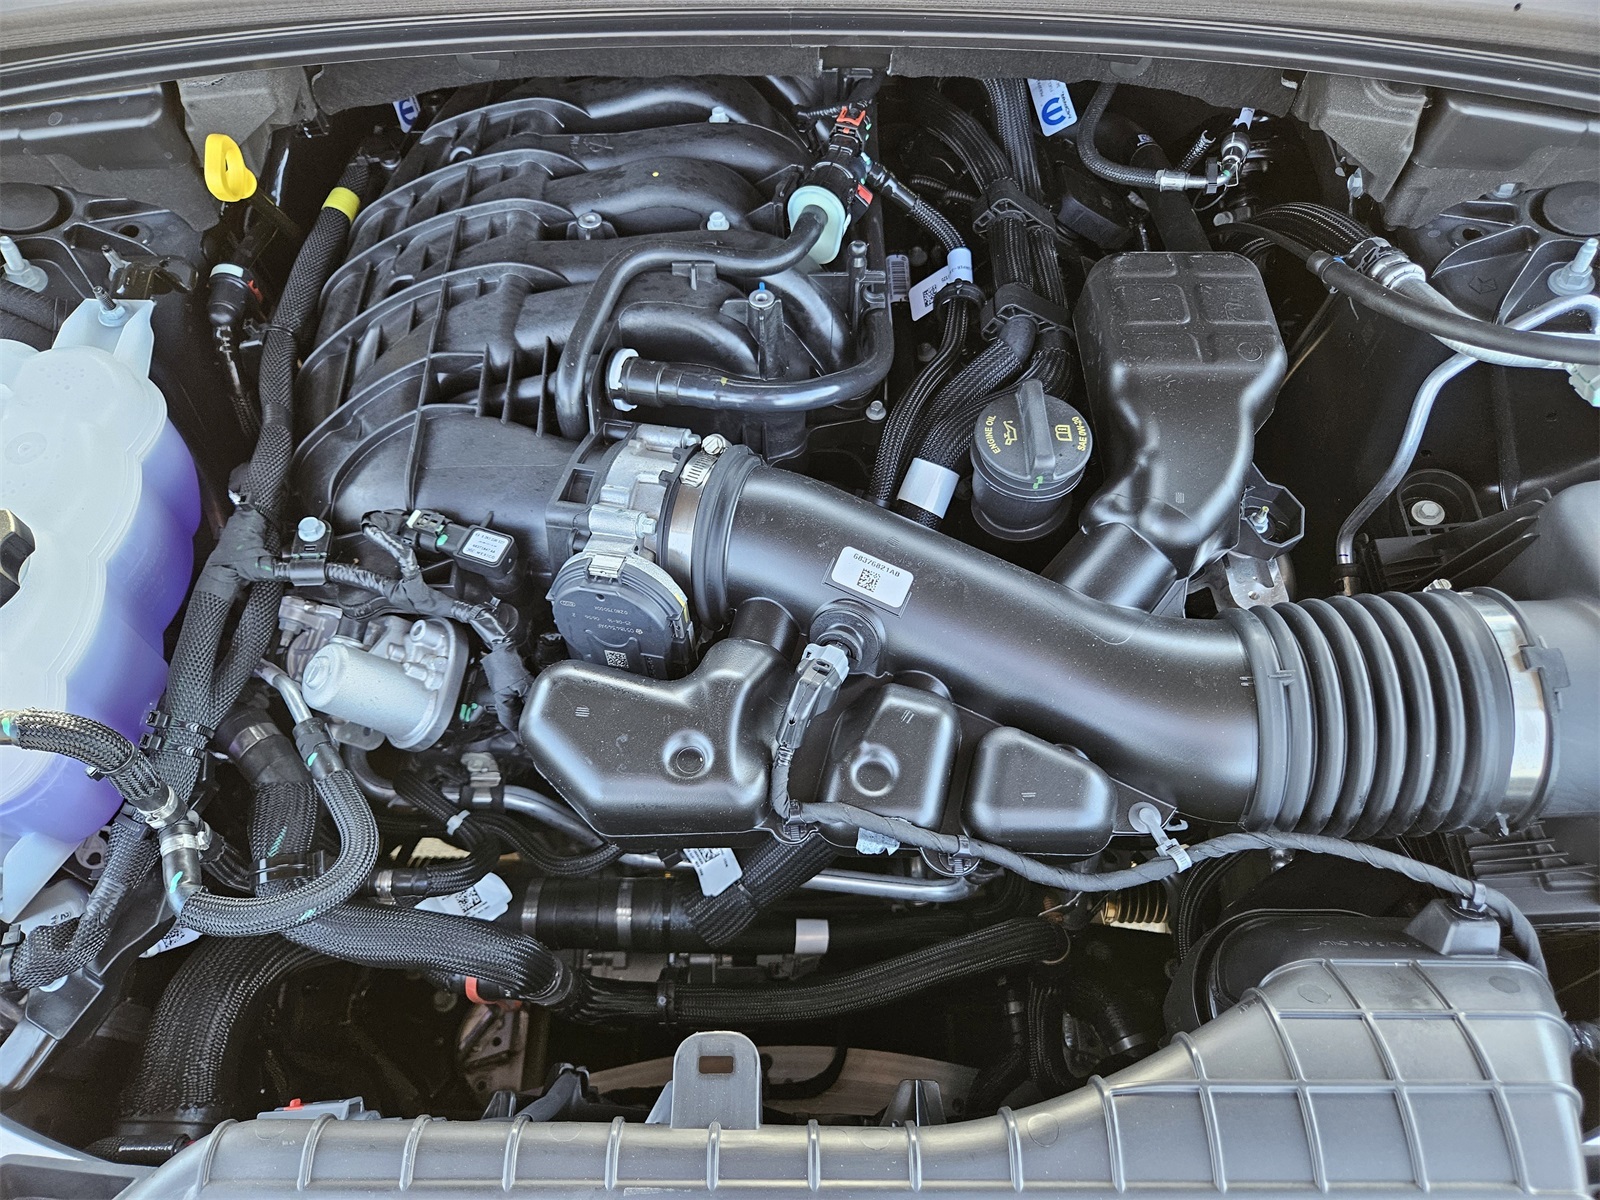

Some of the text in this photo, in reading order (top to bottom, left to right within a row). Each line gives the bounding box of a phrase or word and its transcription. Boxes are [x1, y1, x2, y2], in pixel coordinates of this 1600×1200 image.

[984, 415, 1001, 455] ENGINE OIL
[1071, 416, 1088, 452] SAE 0W-20
[853, 553, 901, 578] 68376821AB
